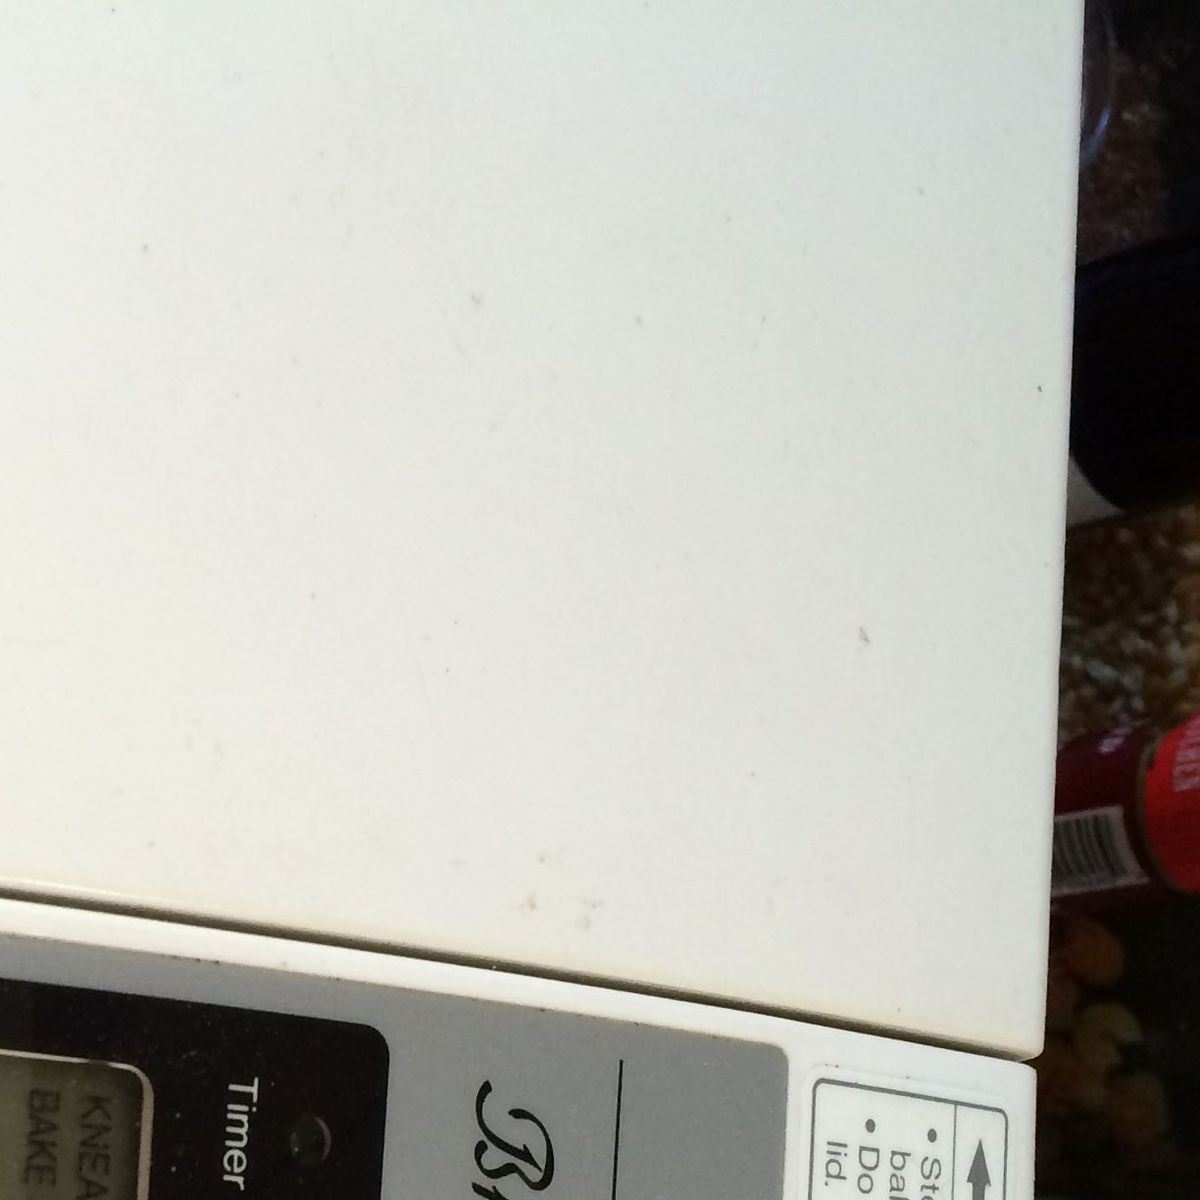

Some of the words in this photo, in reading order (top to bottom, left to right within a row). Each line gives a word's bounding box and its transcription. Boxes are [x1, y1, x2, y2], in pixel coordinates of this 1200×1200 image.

[24, 1089, 60, 1186] BAKE
[222, 1077, 259, 1191] Timer
[824, 1140, 848, 1187] lid.
[857, 1145, 880, 1195] Do
